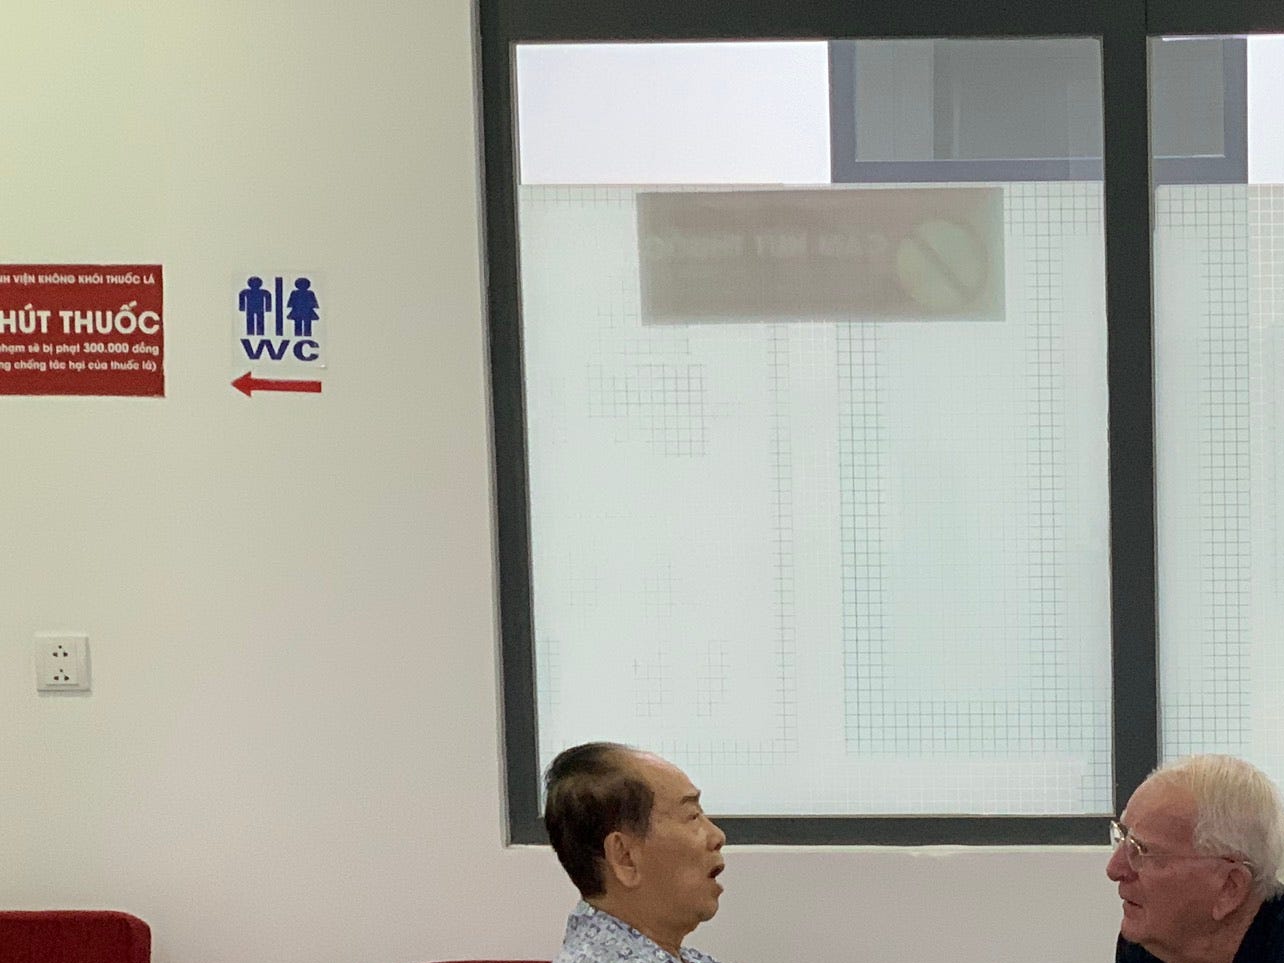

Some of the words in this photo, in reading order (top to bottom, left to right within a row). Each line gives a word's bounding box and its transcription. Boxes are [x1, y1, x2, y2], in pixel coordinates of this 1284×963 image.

[13, 273, 36, 286] VIỆN
[38, 273, 76, 285] KHÔNG
[78, 273, 104, 285] KHÓI
[106, 271, 141, 285] THUỐC
[143, 272, 155, 285] LÁ
[0, 302, 51, 334] HÚT
[59, 300, 160, 335] THUỐC
[0, 343, 26, 355] hạm
[43, 343, 53, 356] bị
[56, 343, 80, 355] phạt
[83, 342, 129, 353] 300.000
[240, 338, 320, 361] WC
[14, 359, 47, 372] chống
[111, 359, 139, 370] thuốc
